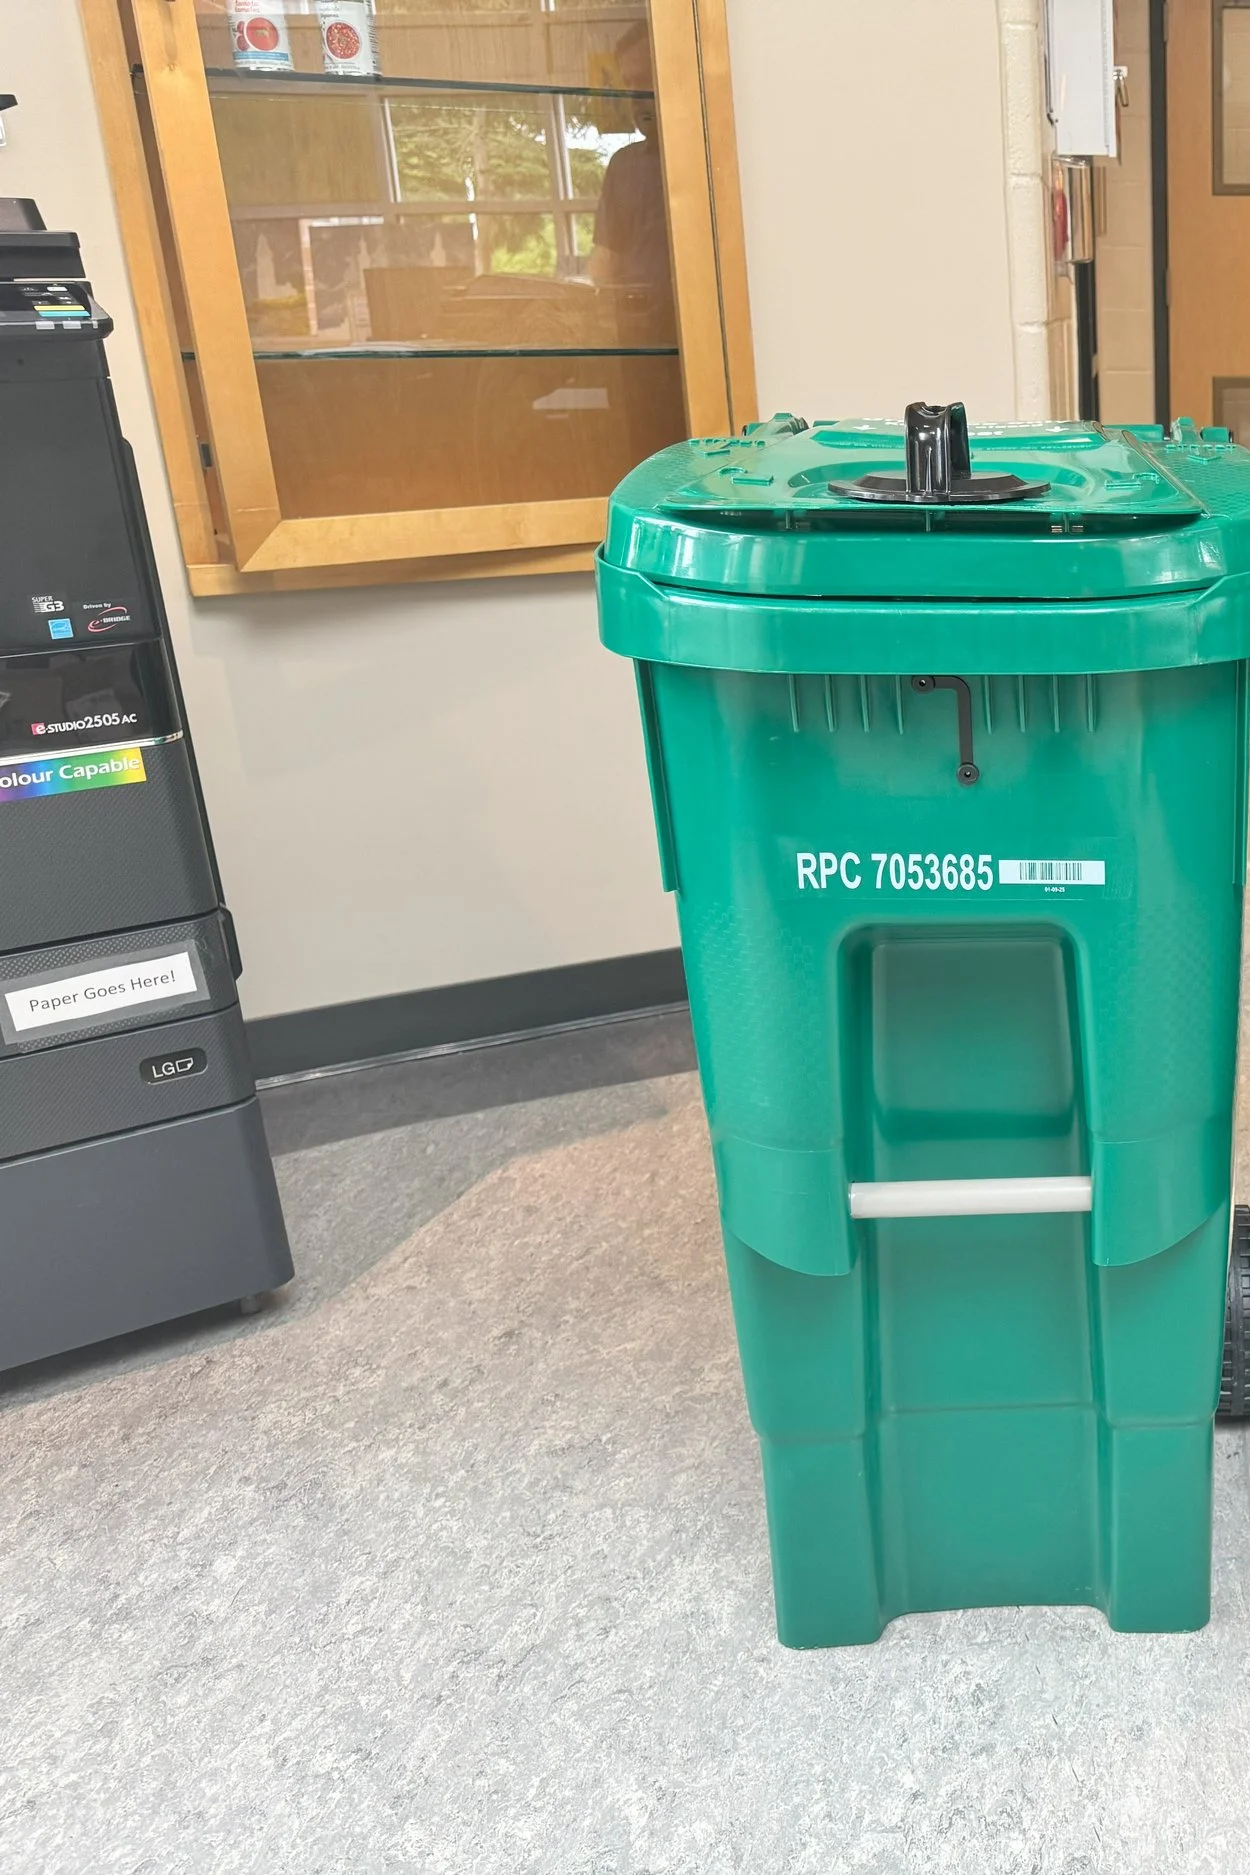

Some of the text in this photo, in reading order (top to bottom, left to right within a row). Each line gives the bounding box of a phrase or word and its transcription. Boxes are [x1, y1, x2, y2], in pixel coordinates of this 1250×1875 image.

[31, 595, 54, 603] SUPER
[40, 600, 65, 613] G3
[0, 756, 141, 788] olour Capable
[796, 851, 994, 891] RPC 7053685
[29, 969, 176, 1012] Paper Goes Here!
[151, 1061, 176, 1079] LG
